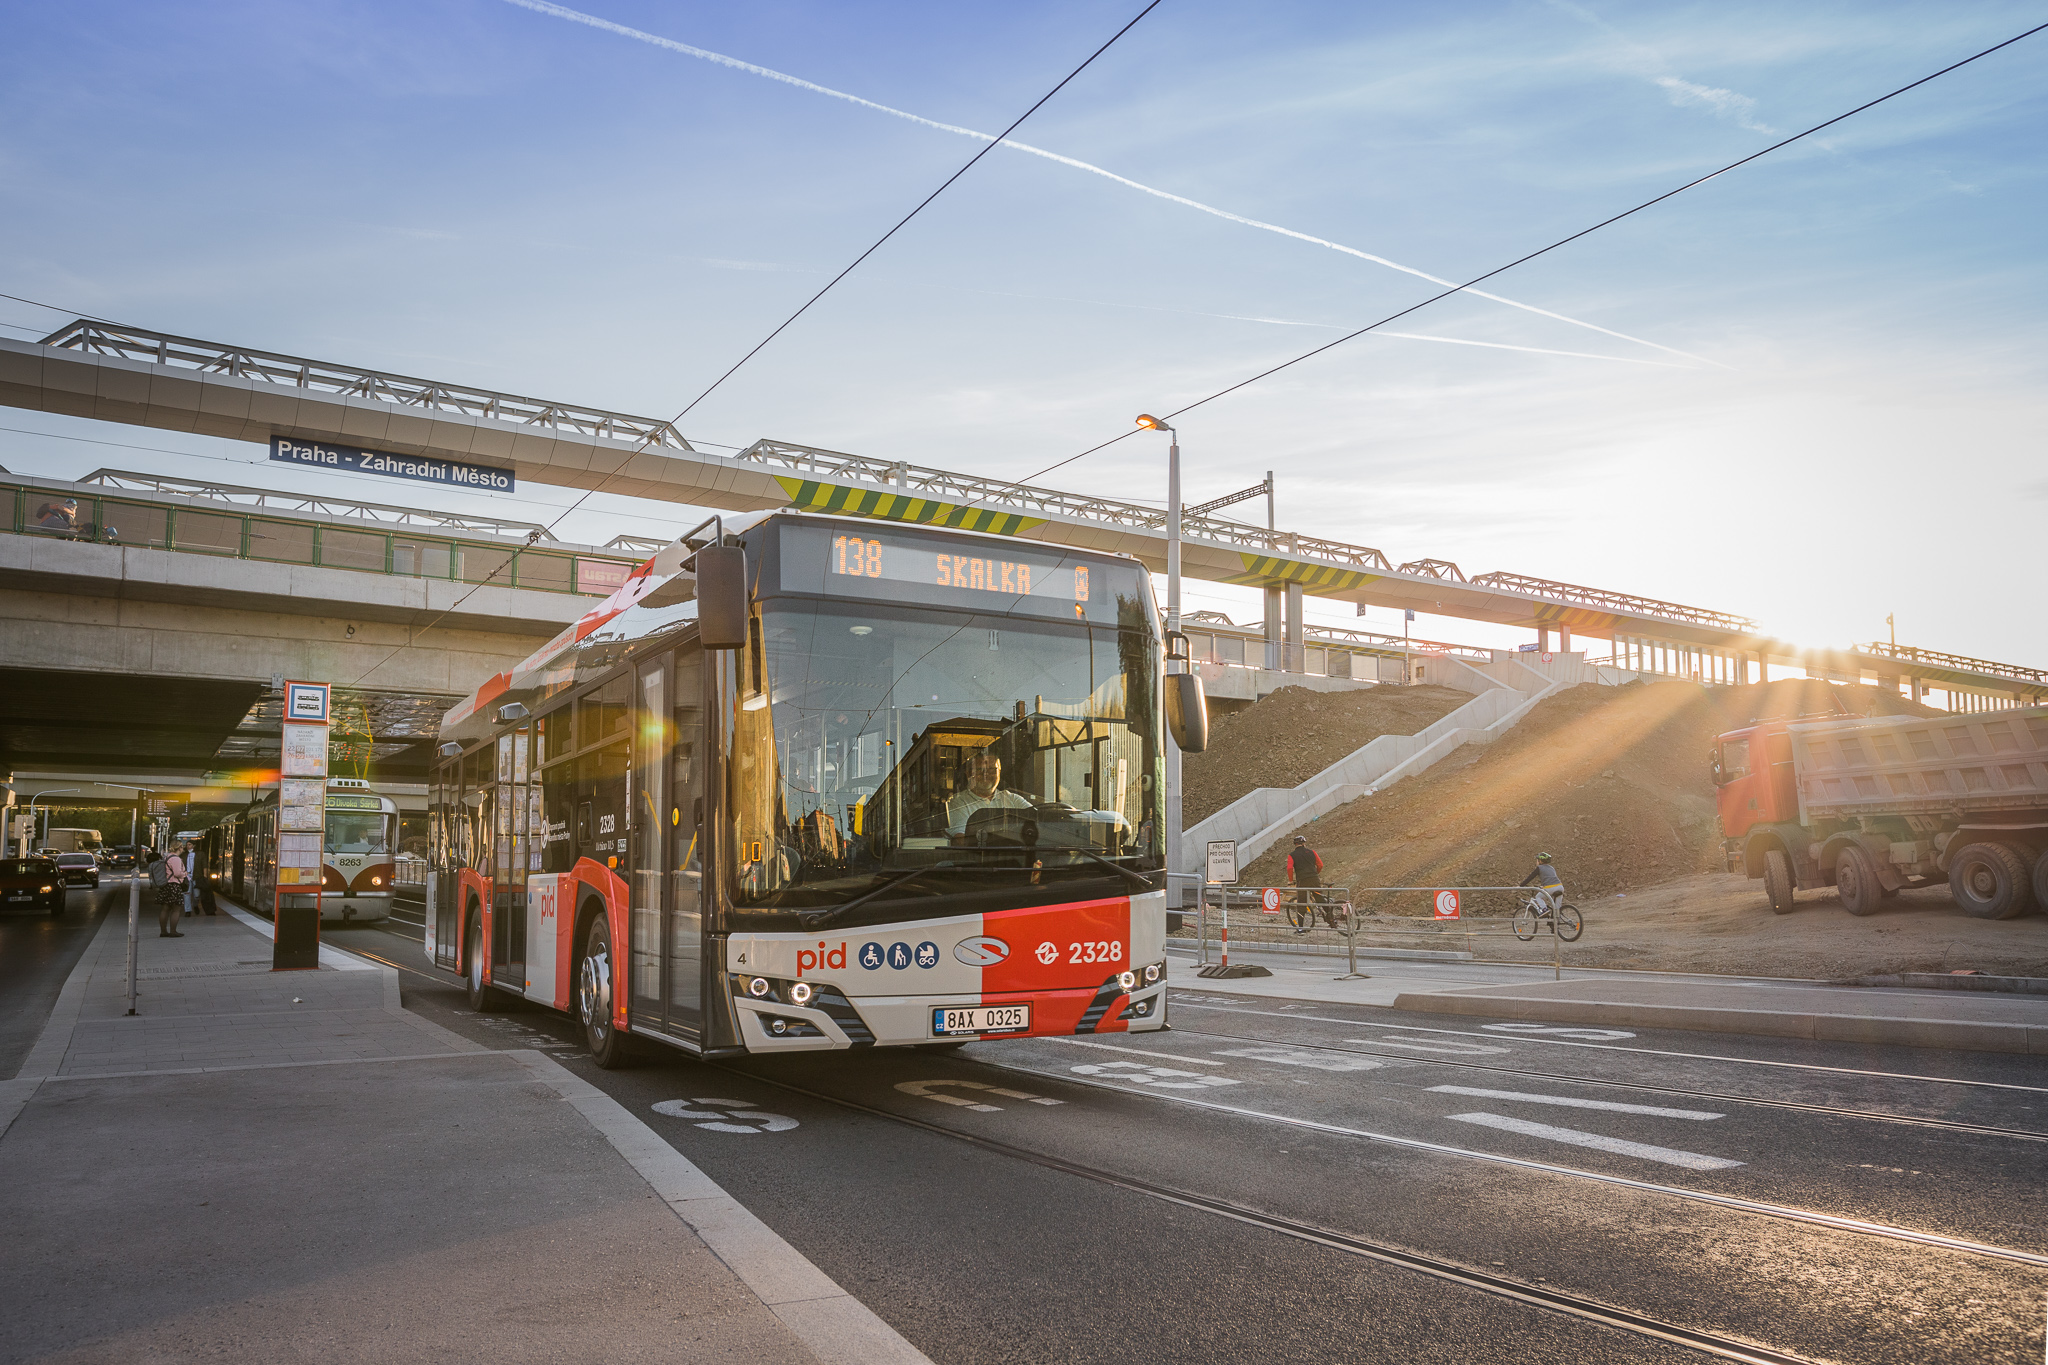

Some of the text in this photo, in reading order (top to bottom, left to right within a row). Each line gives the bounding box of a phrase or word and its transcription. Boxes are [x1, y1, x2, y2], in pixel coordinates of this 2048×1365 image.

[277, 440, 338, 464] Praha
[359, 452, 446, 480] Zahradní
[452, 466, 509, 489] Město
[834, 536, 882, 578] 138
[937, 554, 1031, 595] SKALKA
[600, 814, 615, 834] 2328
[339, 858, 362, 867] 8263
[541, 885, 555, 925] pid
[737, 952, 747, 965] 4
[796, 941, 847, 977] pid
[1069, 940, 1123, 964] 2328
[947, 1008, 1022, 1029] 8AX 0325
